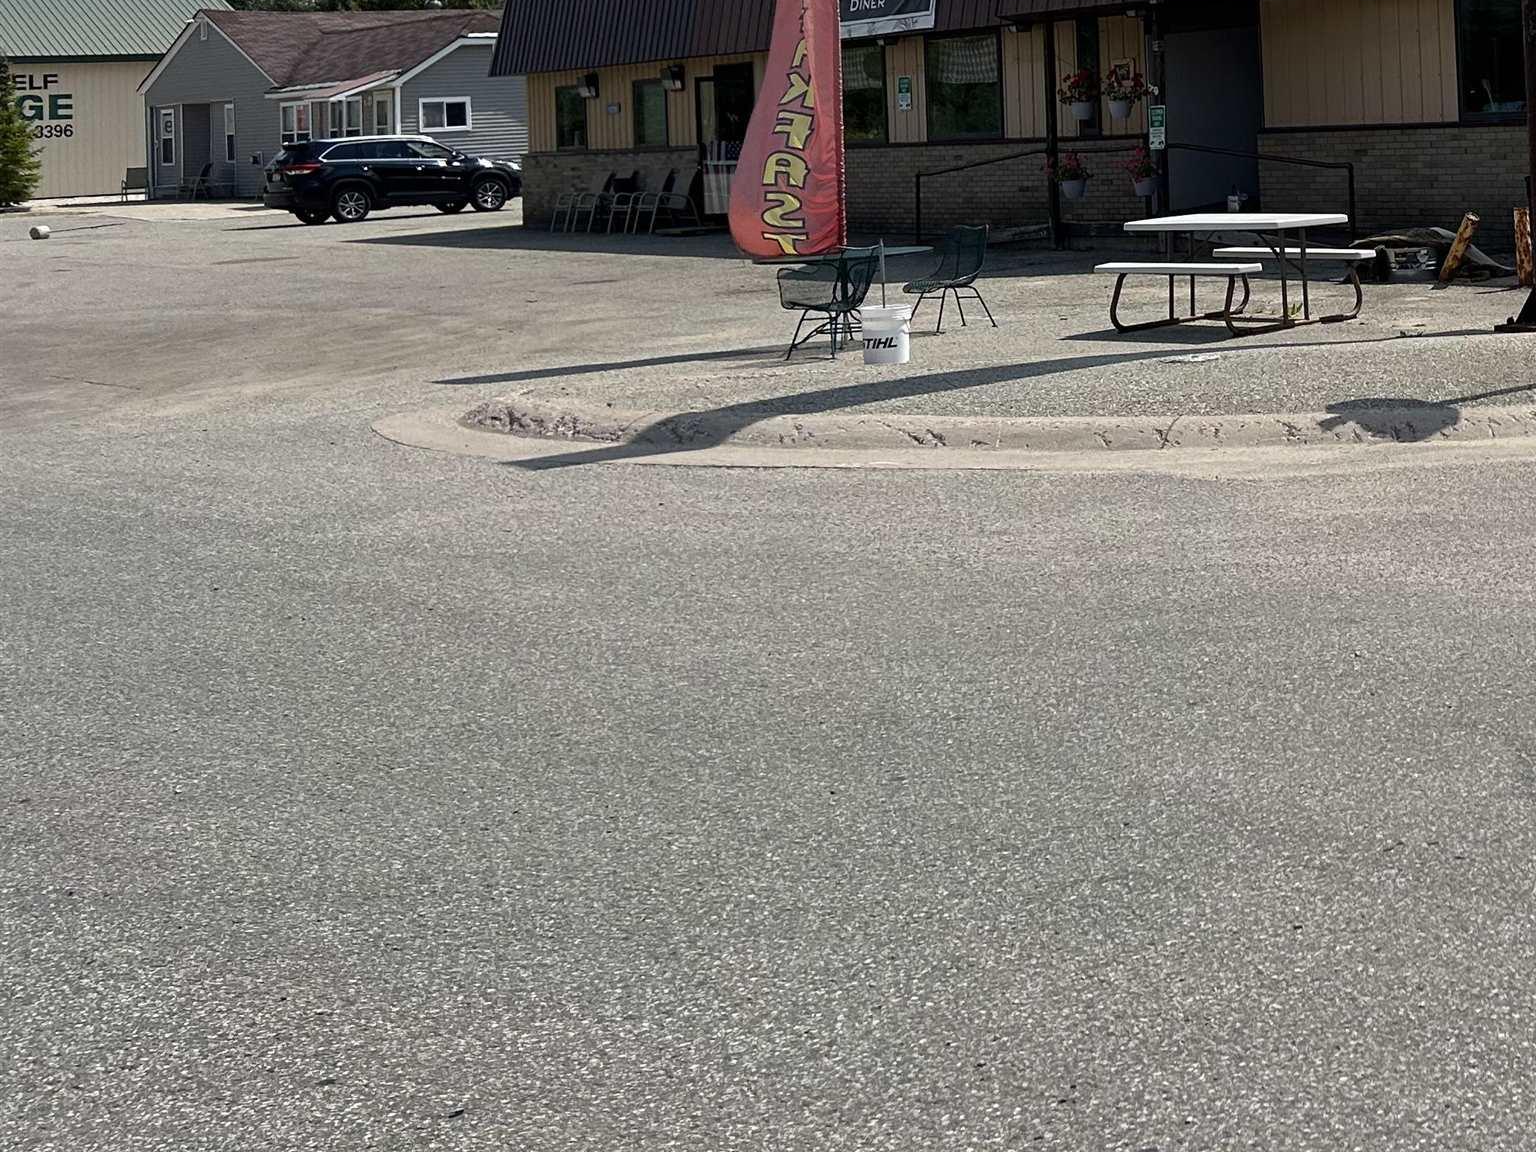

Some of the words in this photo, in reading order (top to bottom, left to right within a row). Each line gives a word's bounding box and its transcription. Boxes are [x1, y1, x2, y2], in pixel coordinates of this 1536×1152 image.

[13, 74, 58, 90] ELF
[33, 124, 73, 138] 3396
[863, 337, 898, 349] TIHL
